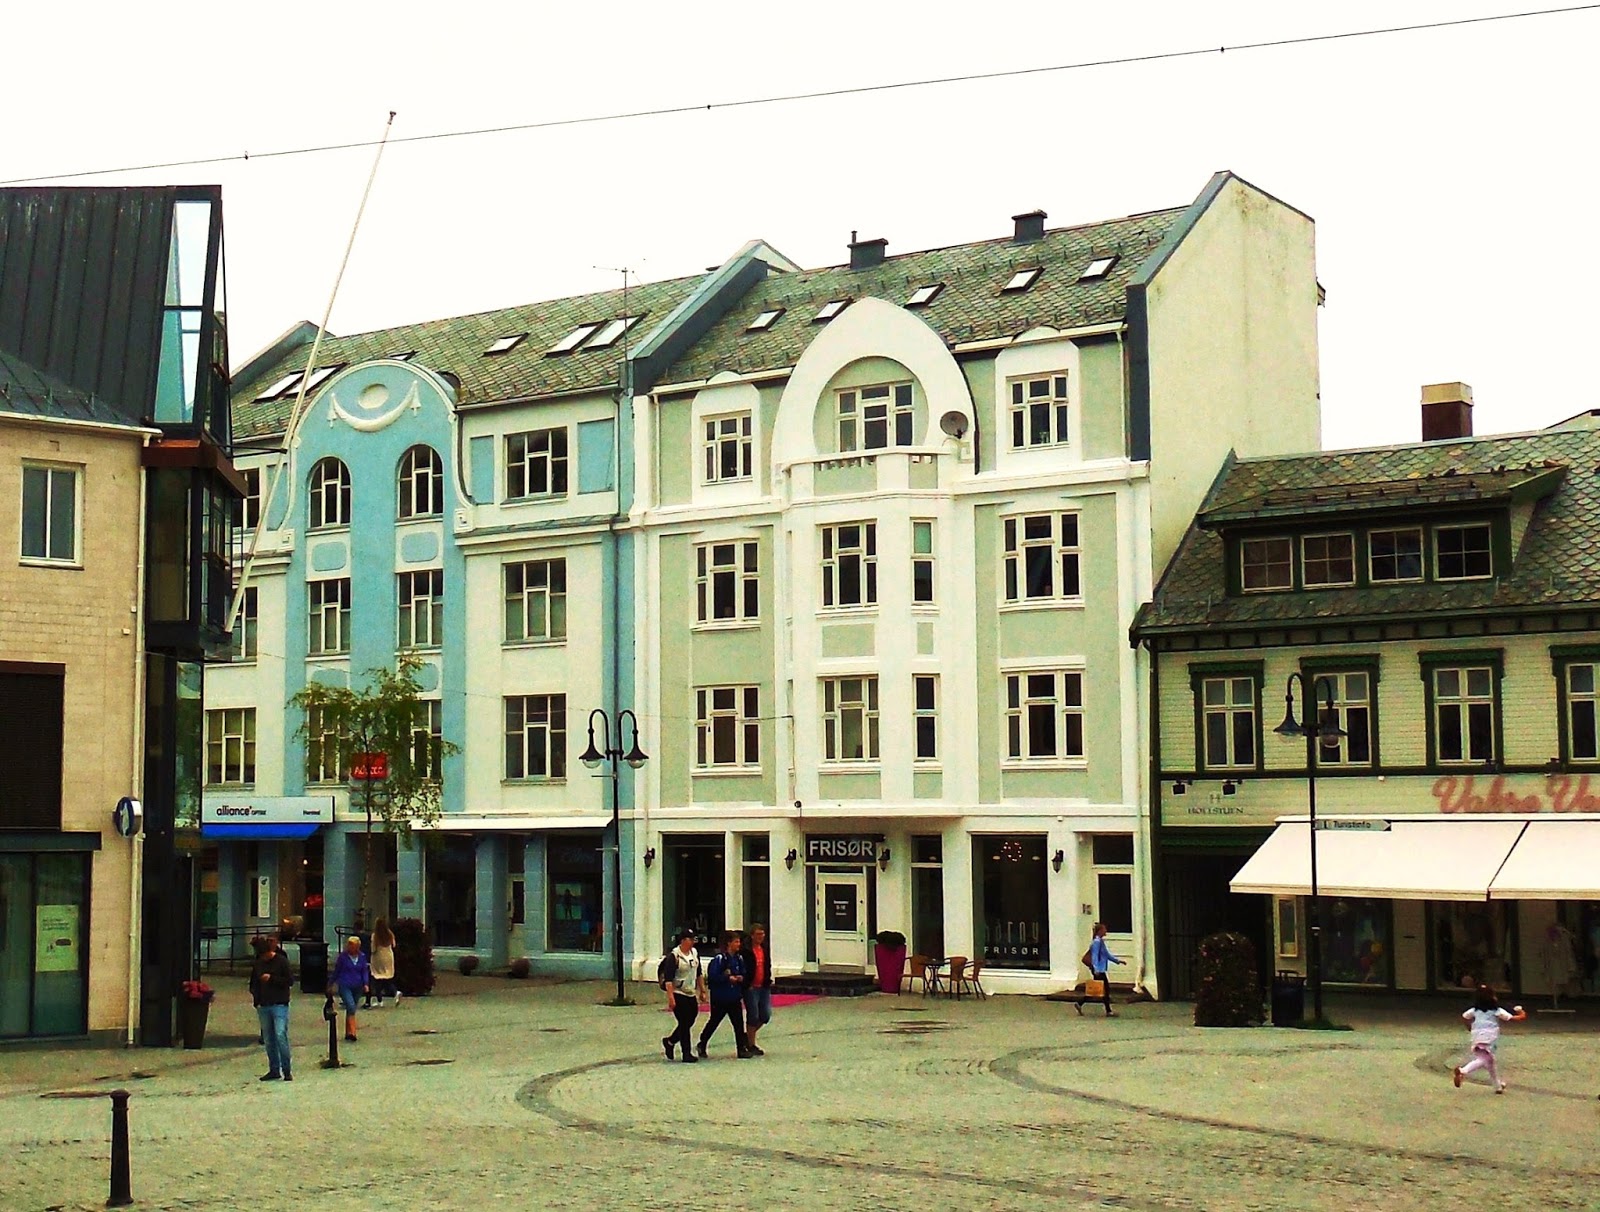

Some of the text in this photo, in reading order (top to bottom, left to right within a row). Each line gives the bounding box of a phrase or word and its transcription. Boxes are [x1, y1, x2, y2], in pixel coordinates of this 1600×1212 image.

[216, 805, 252, 816] alliance
[809, 840, 874, 857] FRISØR
[671, 935, 717, 944] FSØR
[984, 946, 1039, 955] FRISØR
